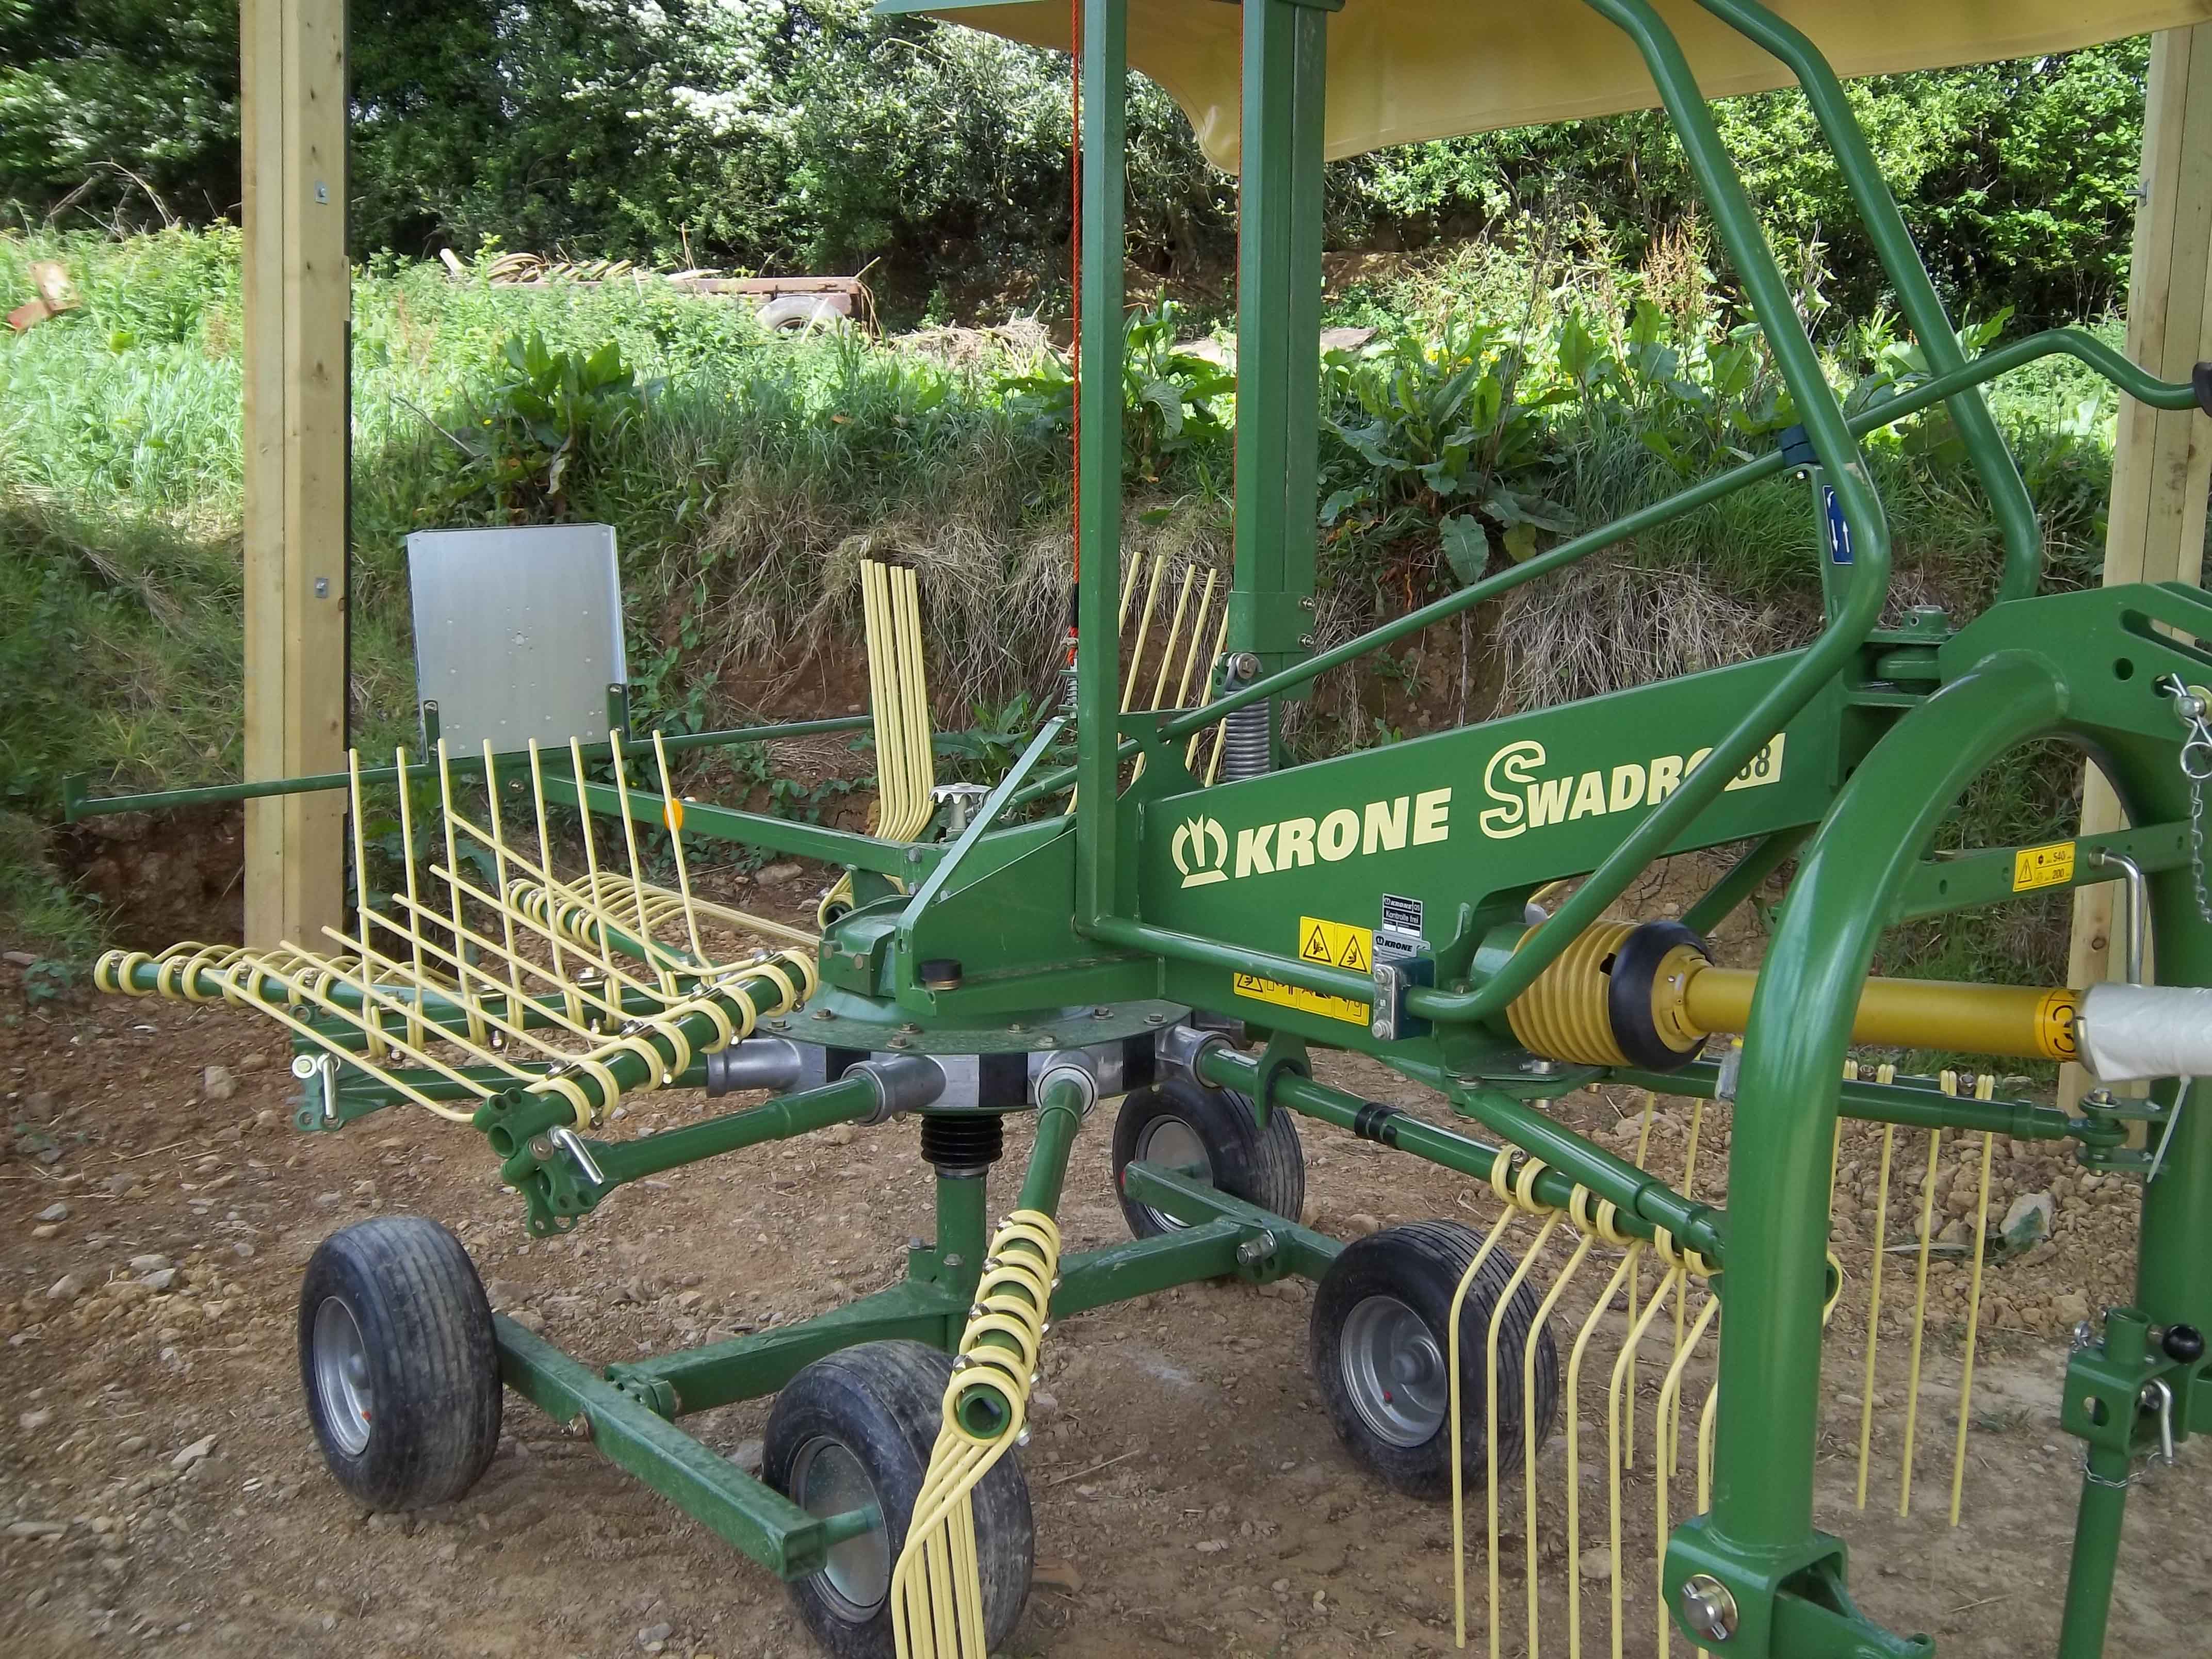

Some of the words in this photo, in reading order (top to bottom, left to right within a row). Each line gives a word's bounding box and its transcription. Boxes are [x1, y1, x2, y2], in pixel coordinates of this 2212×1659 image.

[1235, 787, 1452, 878] KRONE
[1391, 901, 1412, 909] KRONE
[1385, 940, 1412, 952] KRONE
